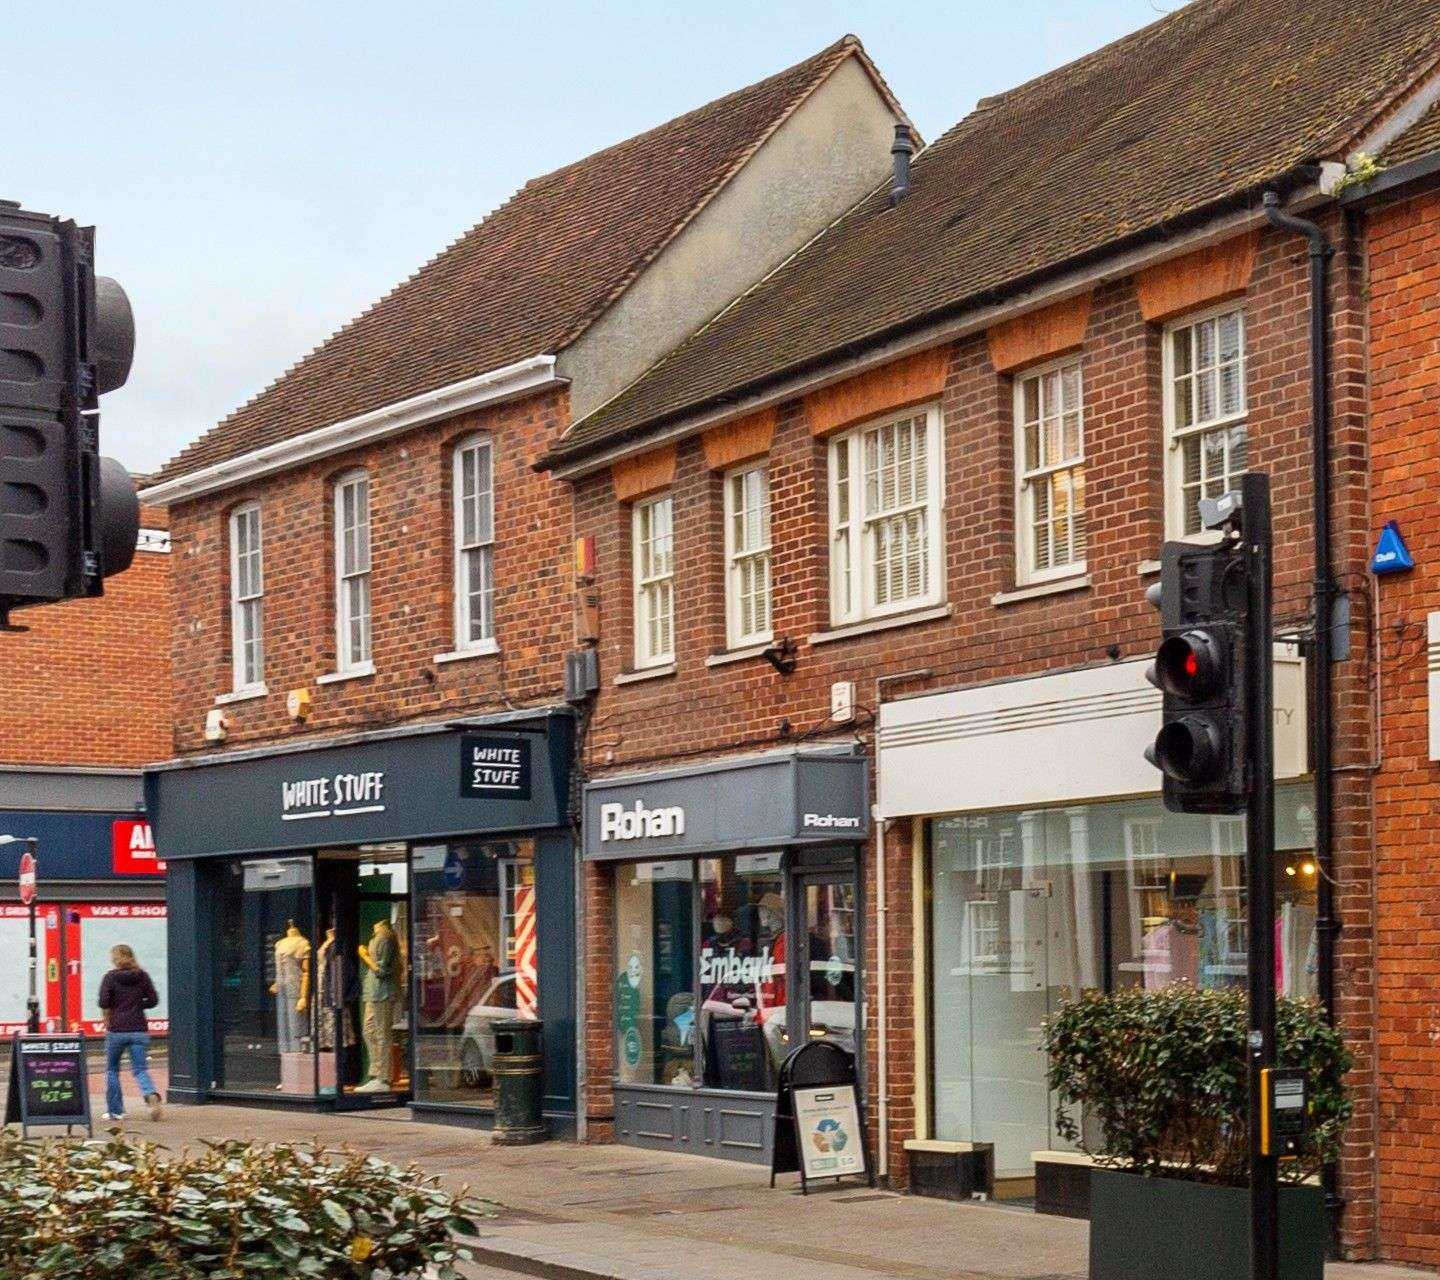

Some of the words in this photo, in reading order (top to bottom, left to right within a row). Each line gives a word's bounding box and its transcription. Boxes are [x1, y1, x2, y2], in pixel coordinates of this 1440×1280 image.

[472, 746, 521, 764] WHITE
[472, 768, 521, 785] STUFF
[281, 777, 329, 811] WHITE
[333, 771, 384, 806] STUFF
[600, 799, 685, 842] Rohan
[803, 813, 860, 828] Rohan
[91, 906, 128, 916] VAPE
[700, 946, 776, 985] Embark
